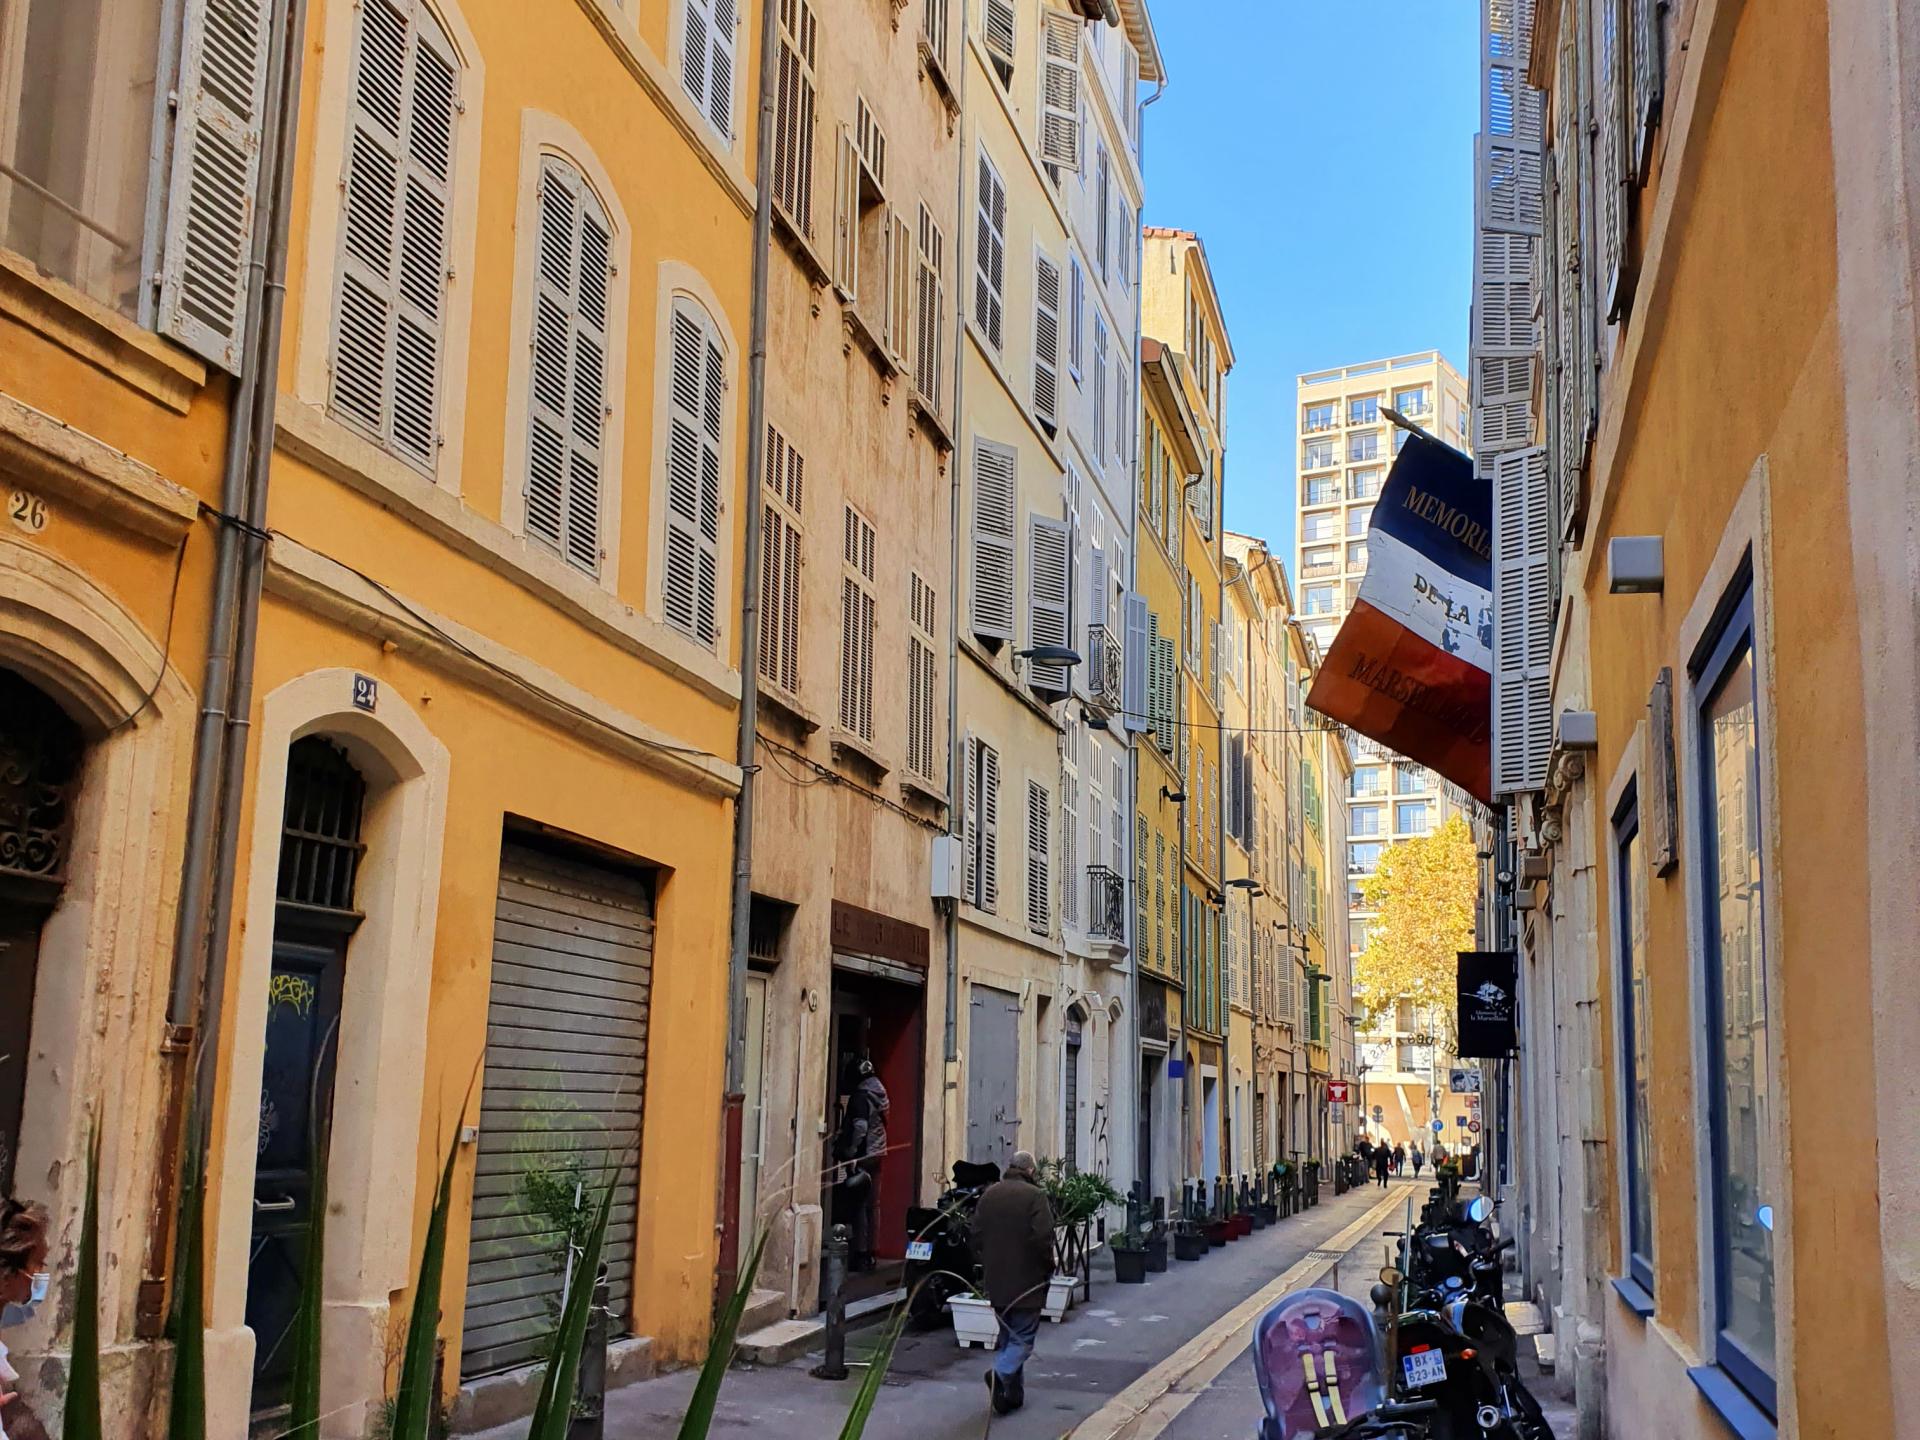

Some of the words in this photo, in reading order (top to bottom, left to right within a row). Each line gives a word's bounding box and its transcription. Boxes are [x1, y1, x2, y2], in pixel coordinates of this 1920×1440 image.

[13, 492, 46, 529] 26
[1413, 573, 1438, 605] DE
[1444, 601, 1471, 625] LA
[357, 680, 375, 706] 24
